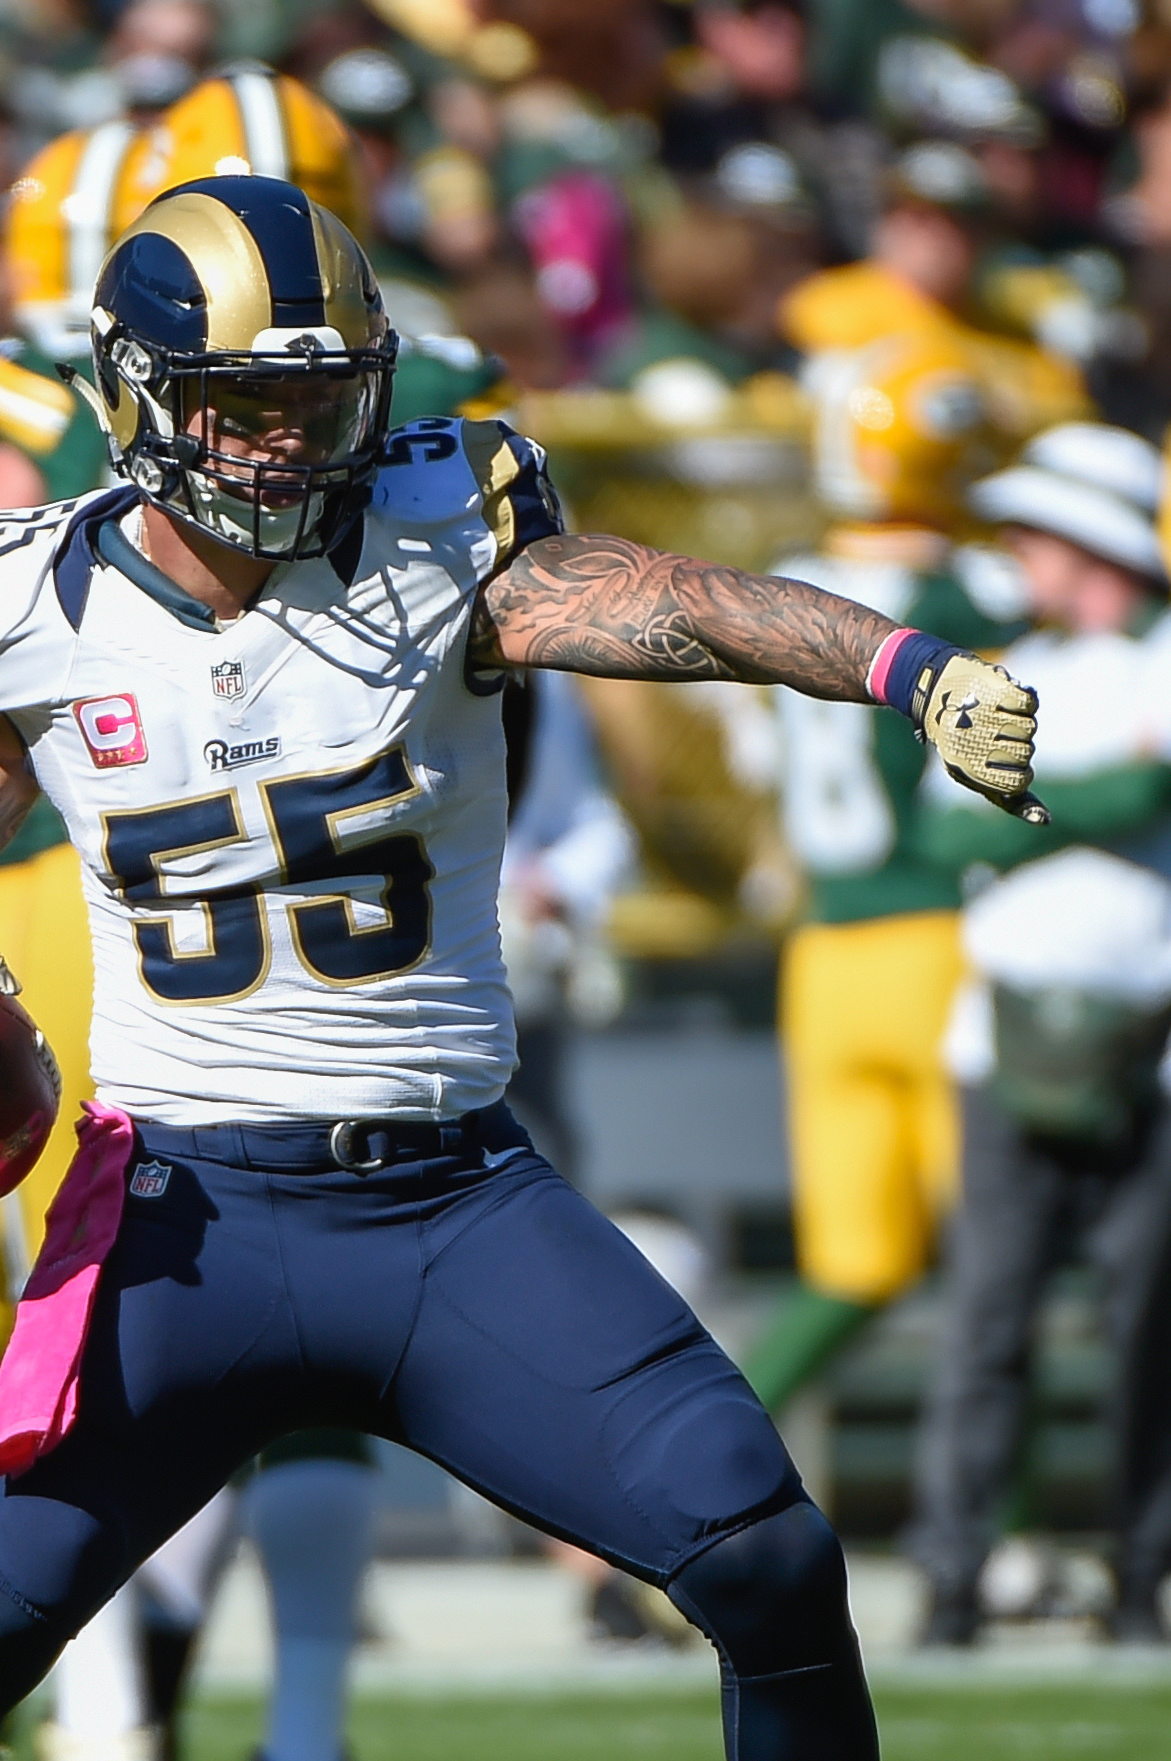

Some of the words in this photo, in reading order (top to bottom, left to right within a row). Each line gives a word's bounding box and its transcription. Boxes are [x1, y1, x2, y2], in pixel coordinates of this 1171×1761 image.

[216, 676, 242, 695] NFL
[80, 698, 136, 750] C
[204, 737, 279, 770] Rams
[99, 740, 434, 1007] 55
[135, 1178, 161, 1192] NFL
